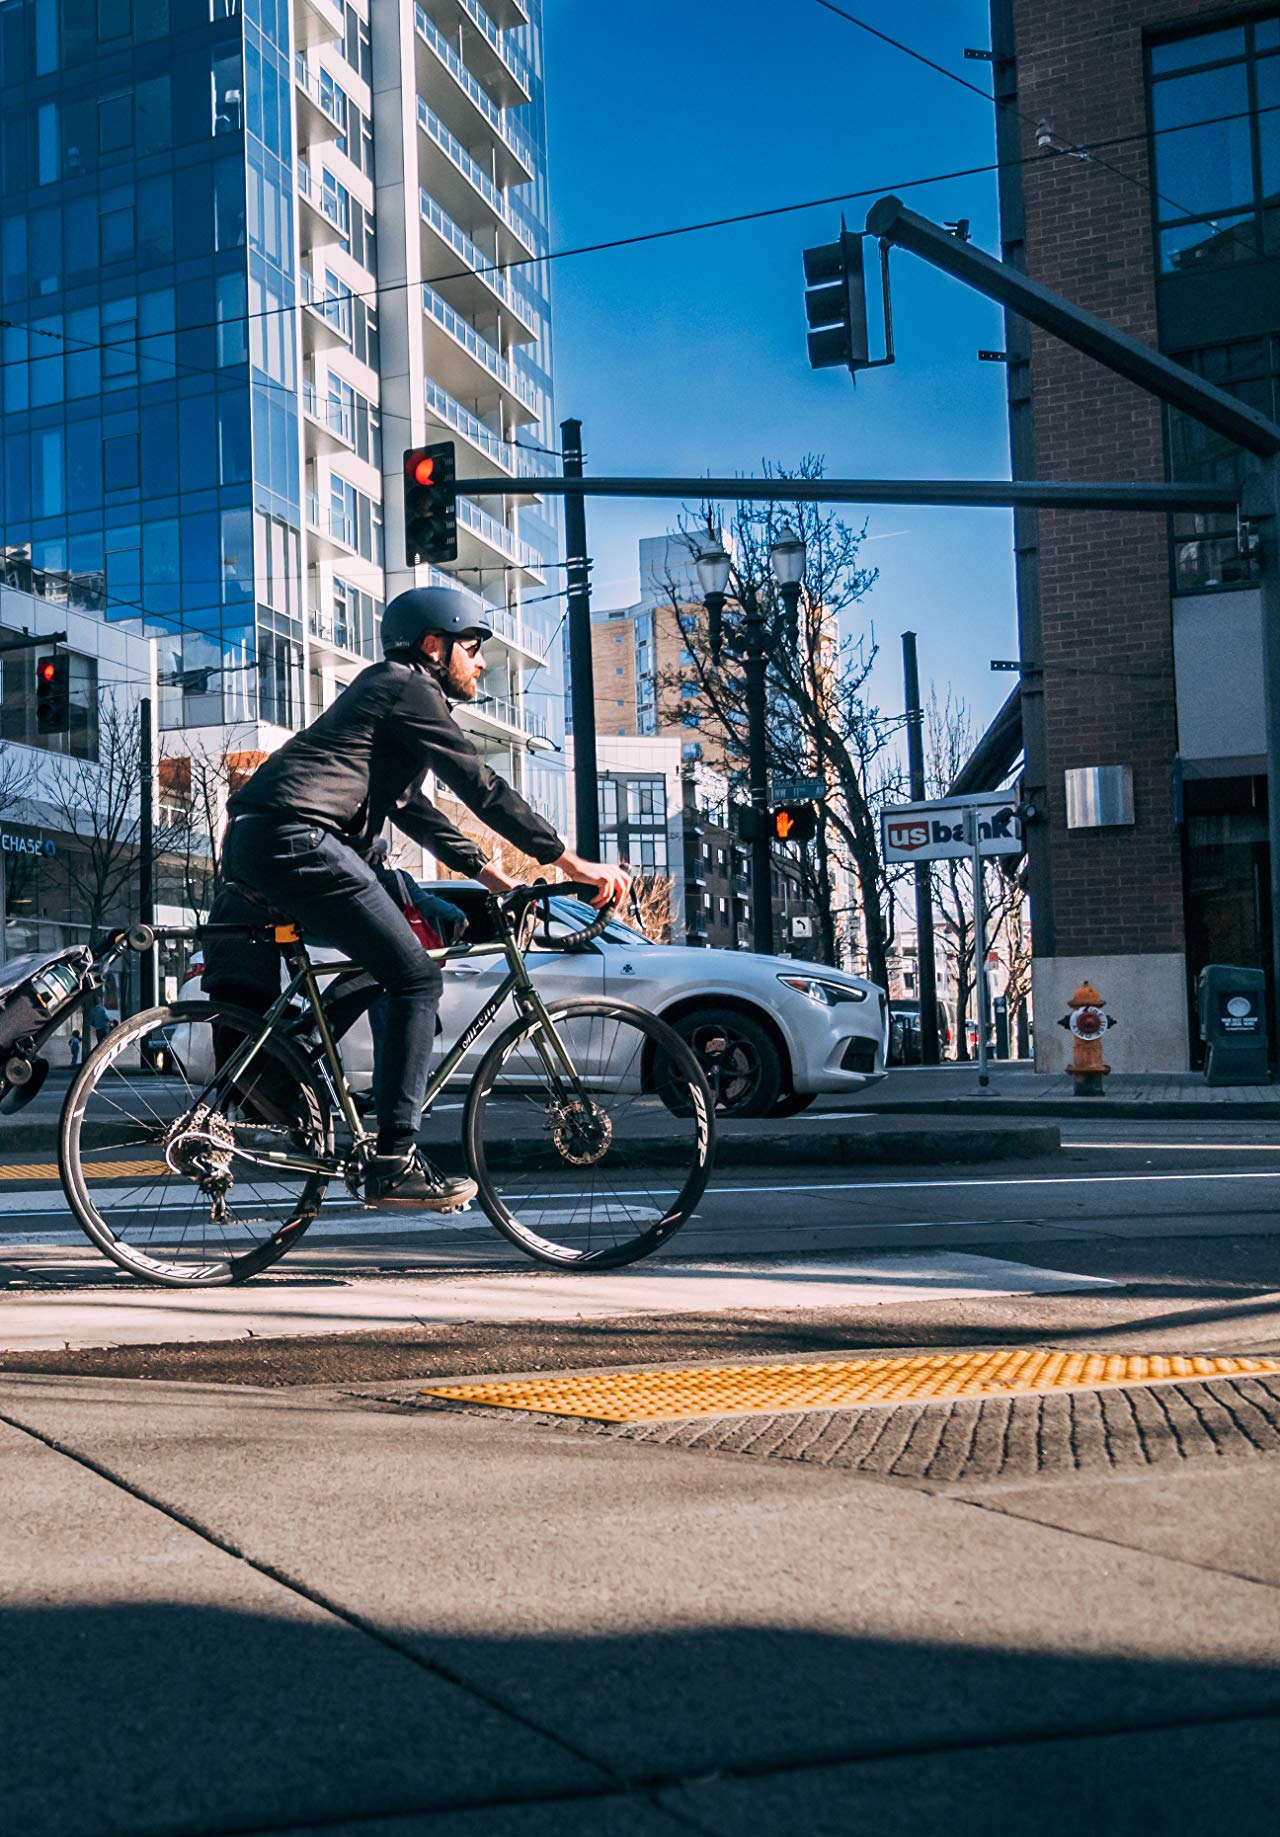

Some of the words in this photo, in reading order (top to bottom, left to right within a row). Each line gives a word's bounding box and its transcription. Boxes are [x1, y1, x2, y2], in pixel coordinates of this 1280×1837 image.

[774, 788, 786, 798] NW
[1, 834, 43, 856] CHASE
[94, 1019, 163, 1084] ZIPP
[688, 1082, 708, 1168] ZIPP
